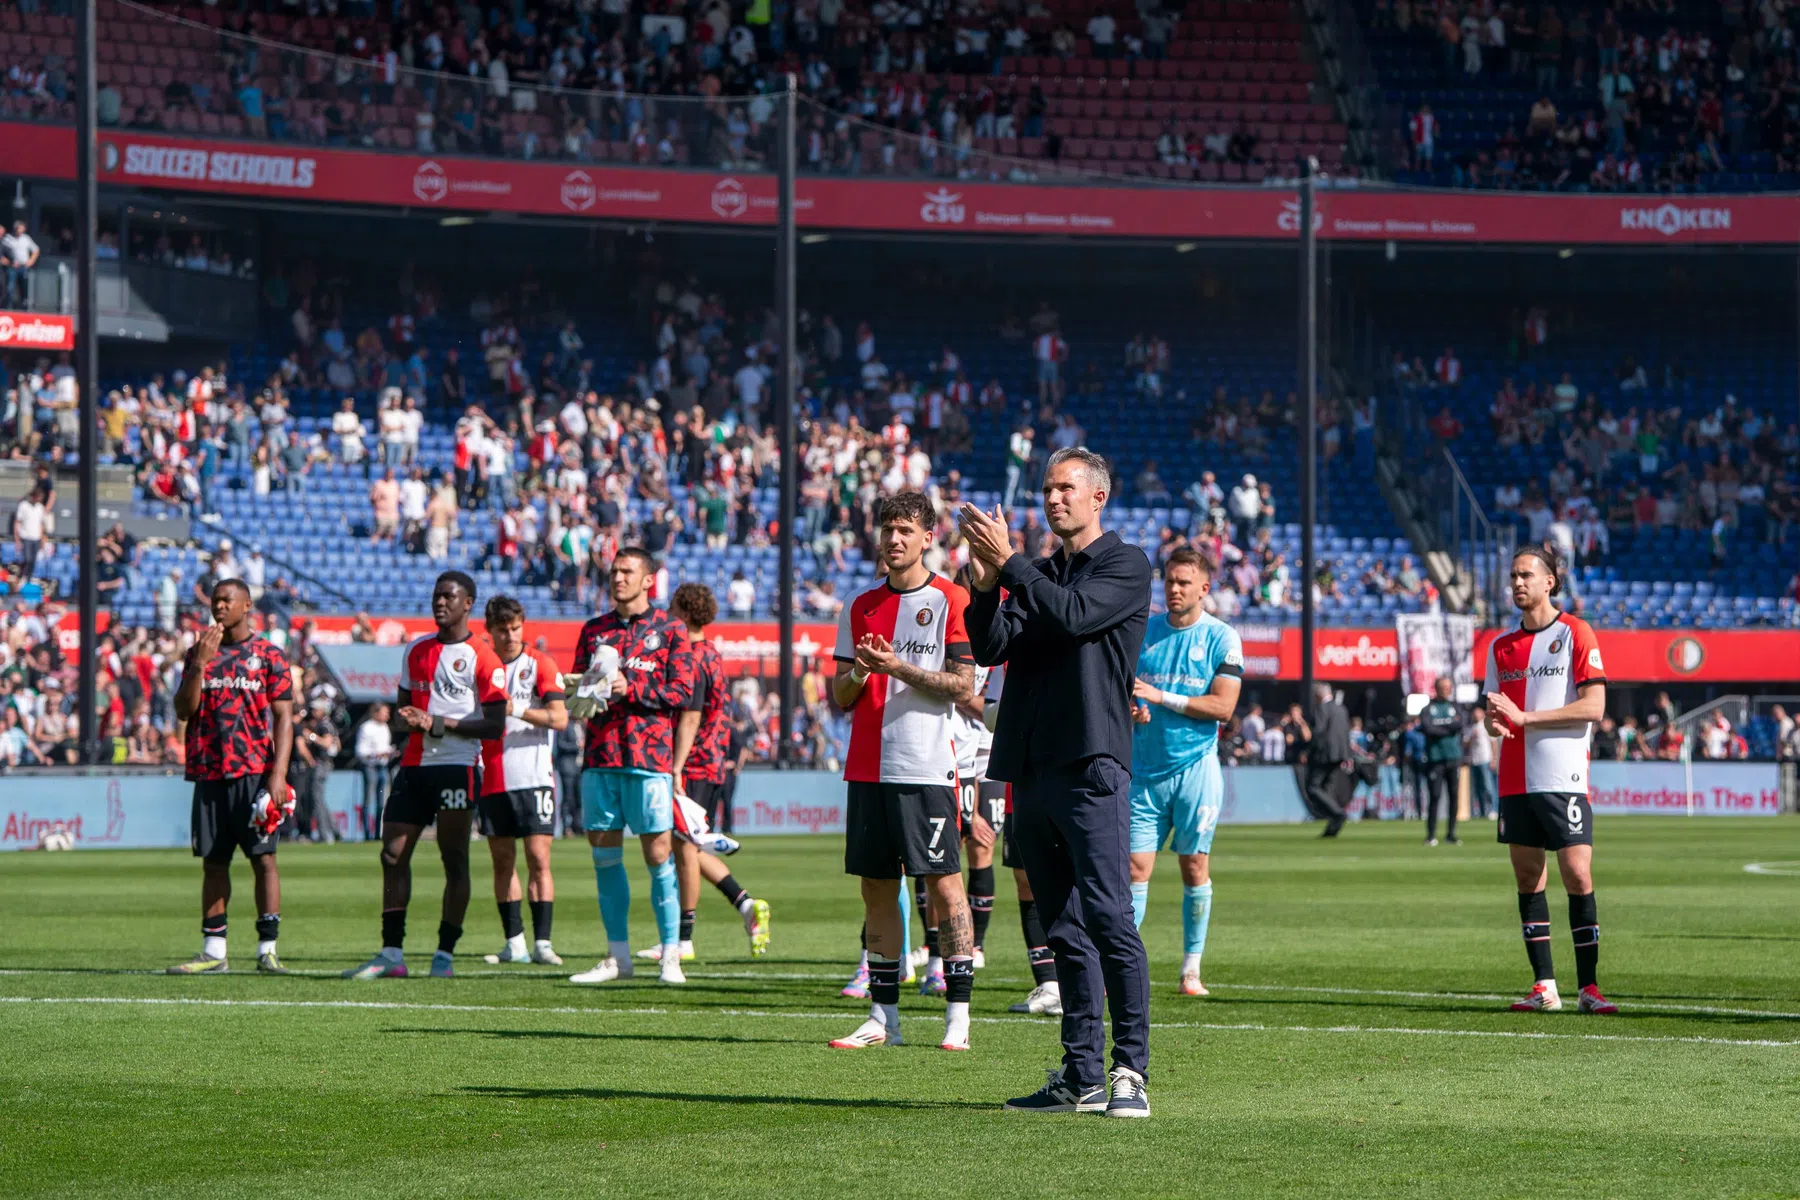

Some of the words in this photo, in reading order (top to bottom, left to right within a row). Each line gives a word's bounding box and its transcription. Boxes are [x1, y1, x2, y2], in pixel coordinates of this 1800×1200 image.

[124, 144, 208, 180] SOCCER
[209, 151, 316, 188] SCHOOLS
[920, 203, 965, 224] CSU
[899, 640, 937, 655] Markt
[1317, 635, 1398, 666] verton
[1533, 665, 1565, 677] Markt
[440, 788, 468, 810] 38
[534, 790, 554, 815] 16
[988, 797, 1006, 823] 18
[1566, 796, 1583, 824] 6
[1711, 786, 1754, 809] The
[754, 801, 783, 825] The
[786, 801, 840, 833] Hague
[928, 817, 947, 849] 7
